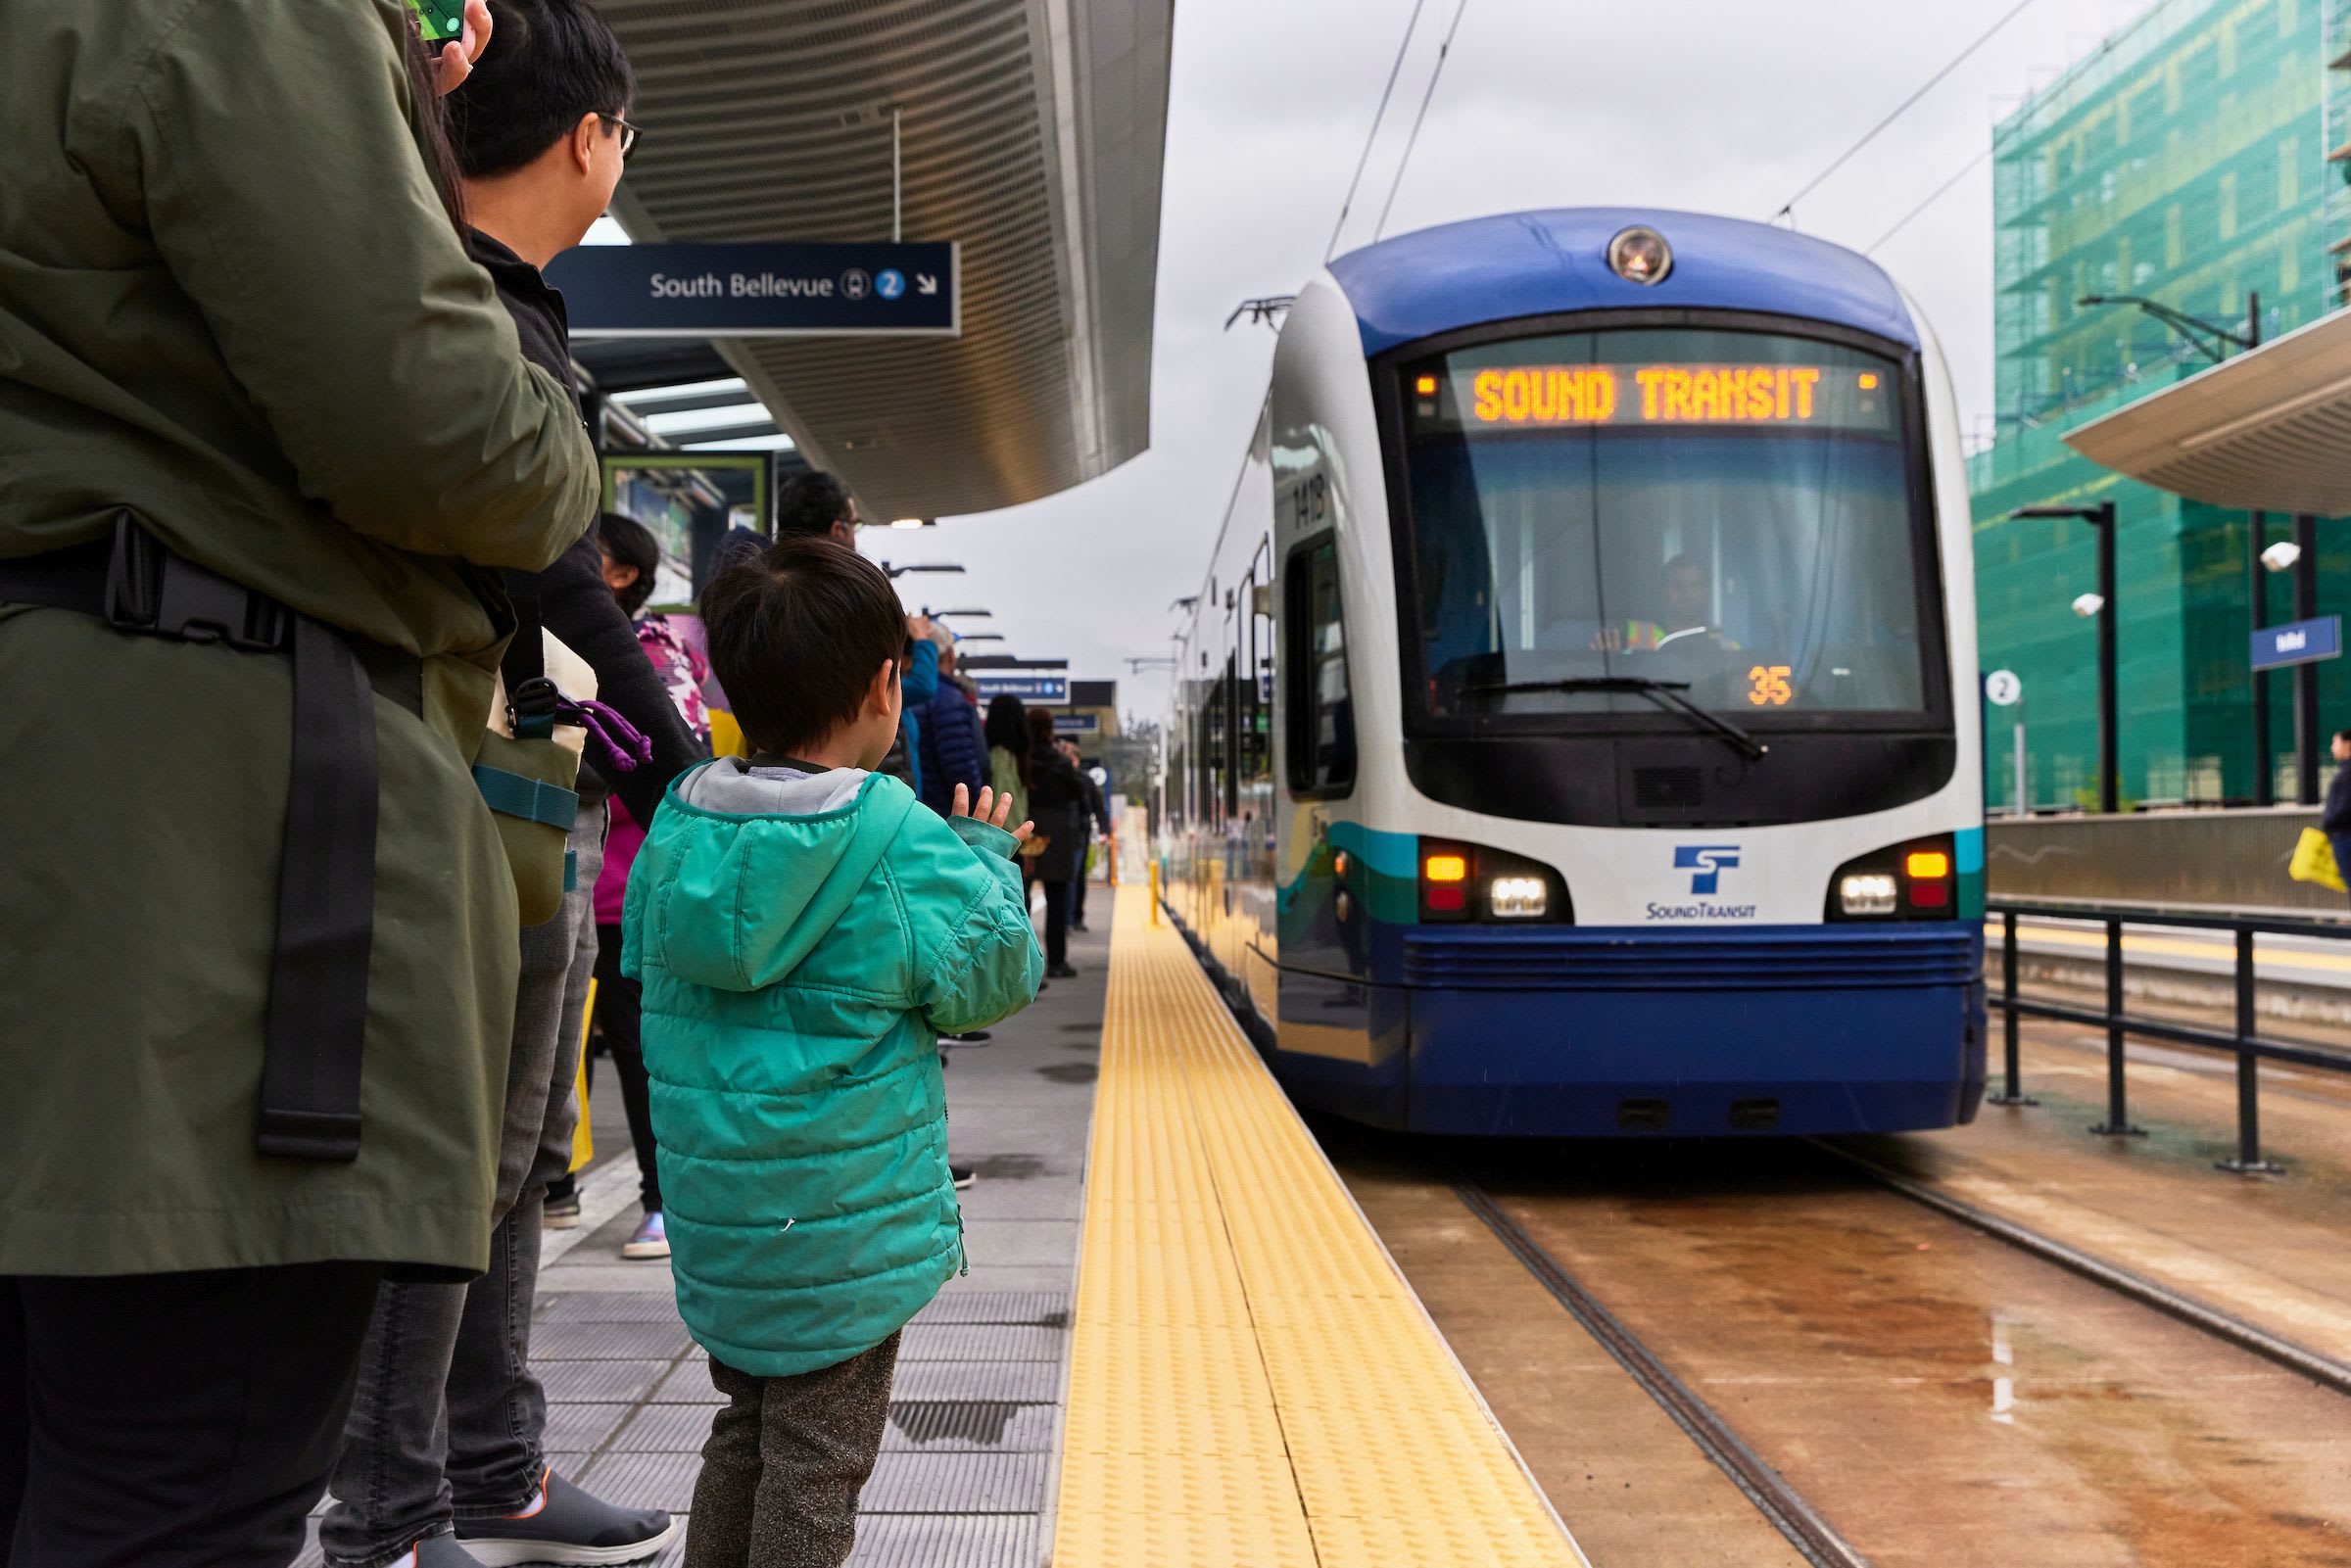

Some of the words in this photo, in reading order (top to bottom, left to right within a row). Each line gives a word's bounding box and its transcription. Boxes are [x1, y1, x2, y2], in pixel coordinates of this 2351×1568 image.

[649, 271, 723, 298] South
[730, 271, 834, 298] Bellevue
[883, 273, 898, 296] 2
[1473, 368, 1616, 422] SOUND
[1635, 366, 1820, 421] TRANSIT
[1748, 665, 1792, 705] 35
